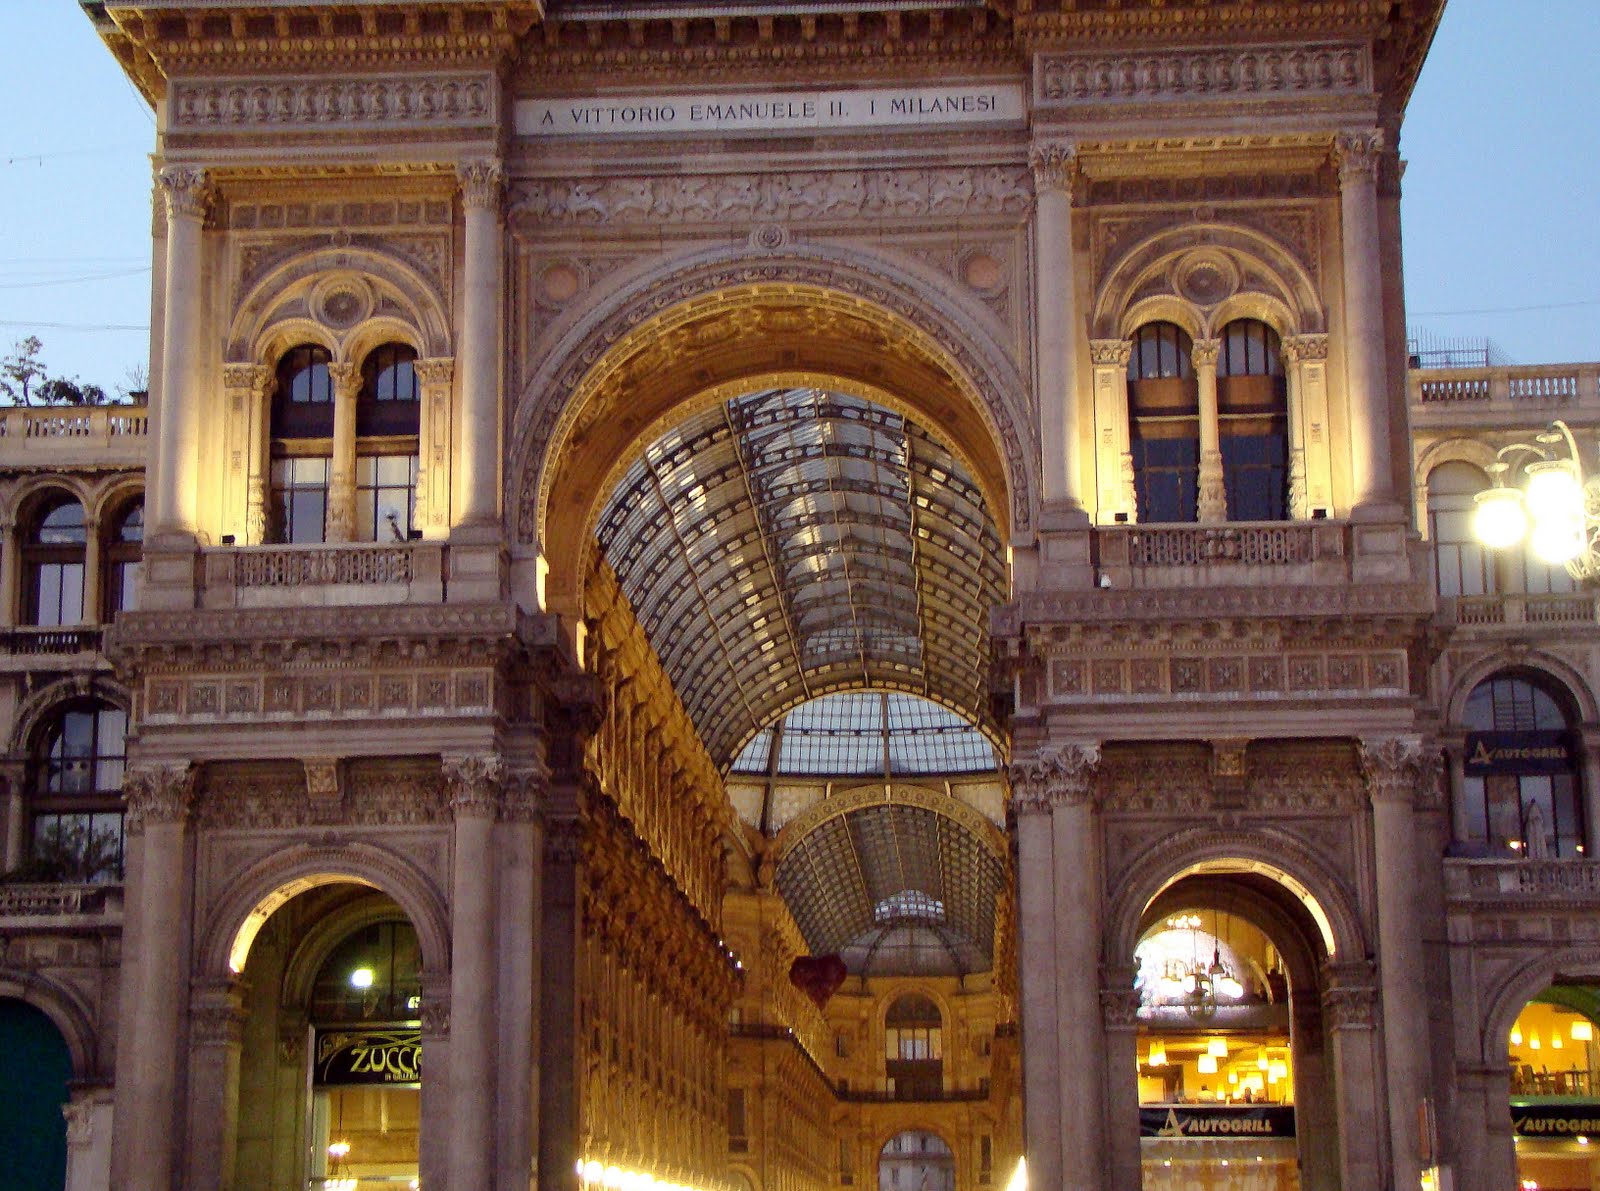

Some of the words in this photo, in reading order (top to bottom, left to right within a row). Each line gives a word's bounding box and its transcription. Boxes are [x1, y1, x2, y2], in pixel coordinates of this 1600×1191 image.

[541, 109, 554, 126] A
[570, 105, 675, 124] VITTORIO
[689, 101, 816, 121] EMANUELE
[890, 95, 996, 115] MILANESI
[1188, 1118, 1273, 1134] AUTOGRILL
